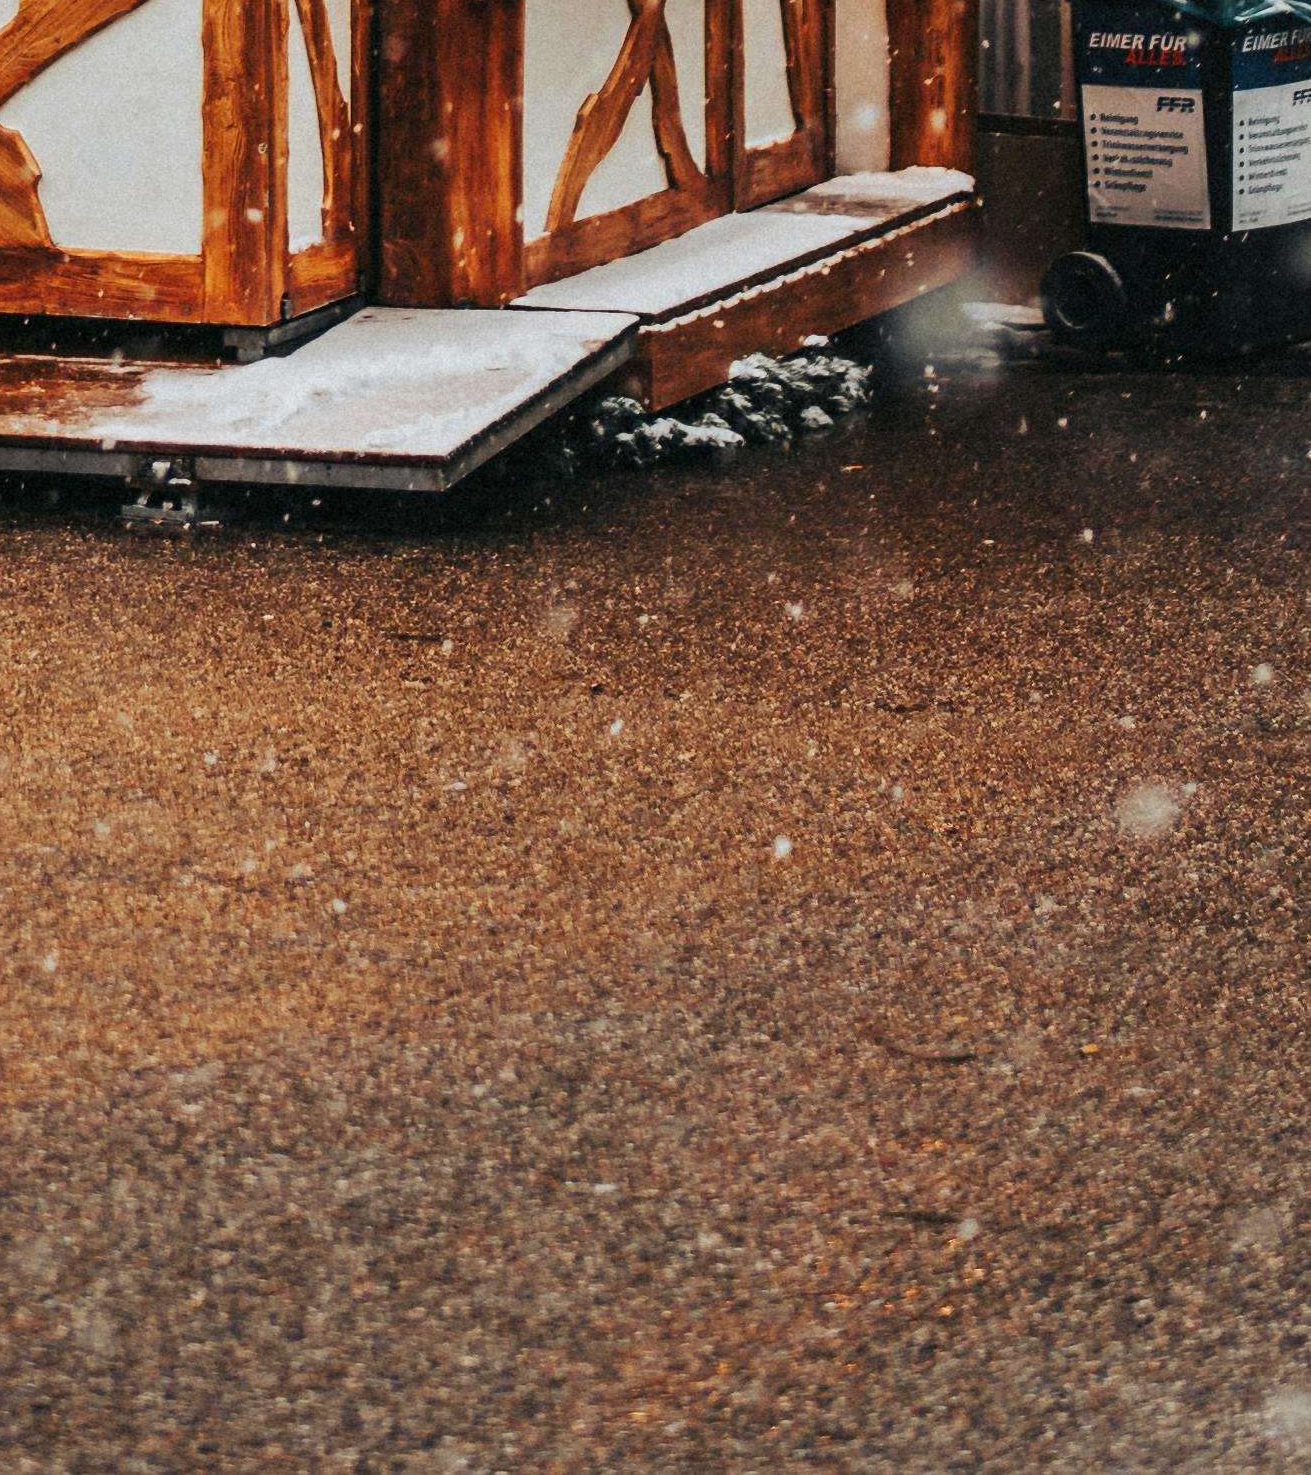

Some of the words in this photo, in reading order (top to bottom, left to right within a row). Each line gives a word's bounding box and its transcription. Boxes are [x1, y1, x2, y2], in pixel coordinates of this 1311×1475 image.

[1089, 32, 1145, 50] EIMER
[1149, 32, 1187, 52] FÜR
[1242, 31, 1289, 53] EIMER
[1157, 96, 1196, 114] FFR
